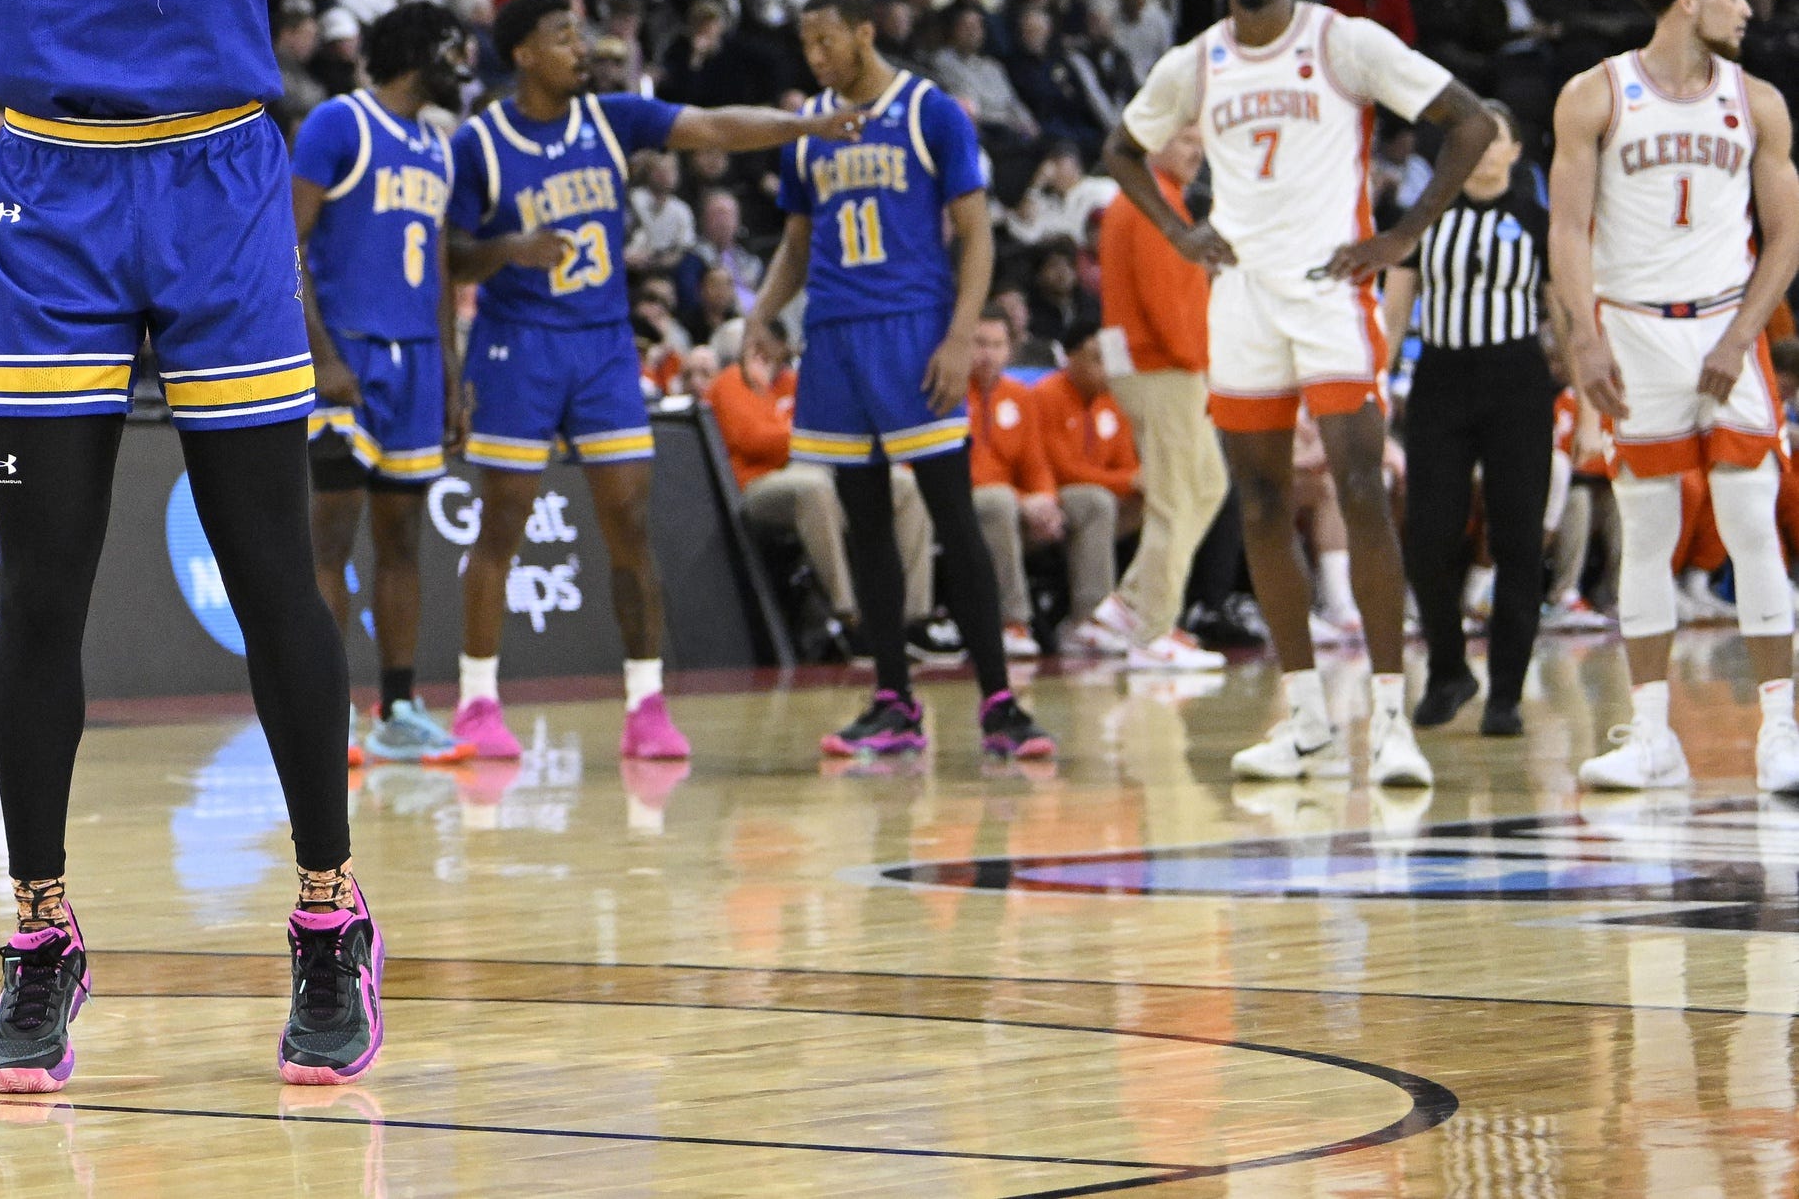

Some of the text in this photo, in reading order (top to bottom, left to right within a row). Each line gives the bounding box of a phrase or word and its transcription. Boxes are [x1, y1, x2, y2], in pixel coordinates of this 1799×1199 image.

[1212, 89, 1320, 135] CLEMSON
[1251, 125, 1280, 181] 7
[837, 197, 887, 268] 11
[1672, 172, 1692, 232] 1
[403, 220, 427, 288] 6
[549, 220, 612, 296] 23
[428, 477, 578, 544] Gat
[458, 555, 583, 633] ips
